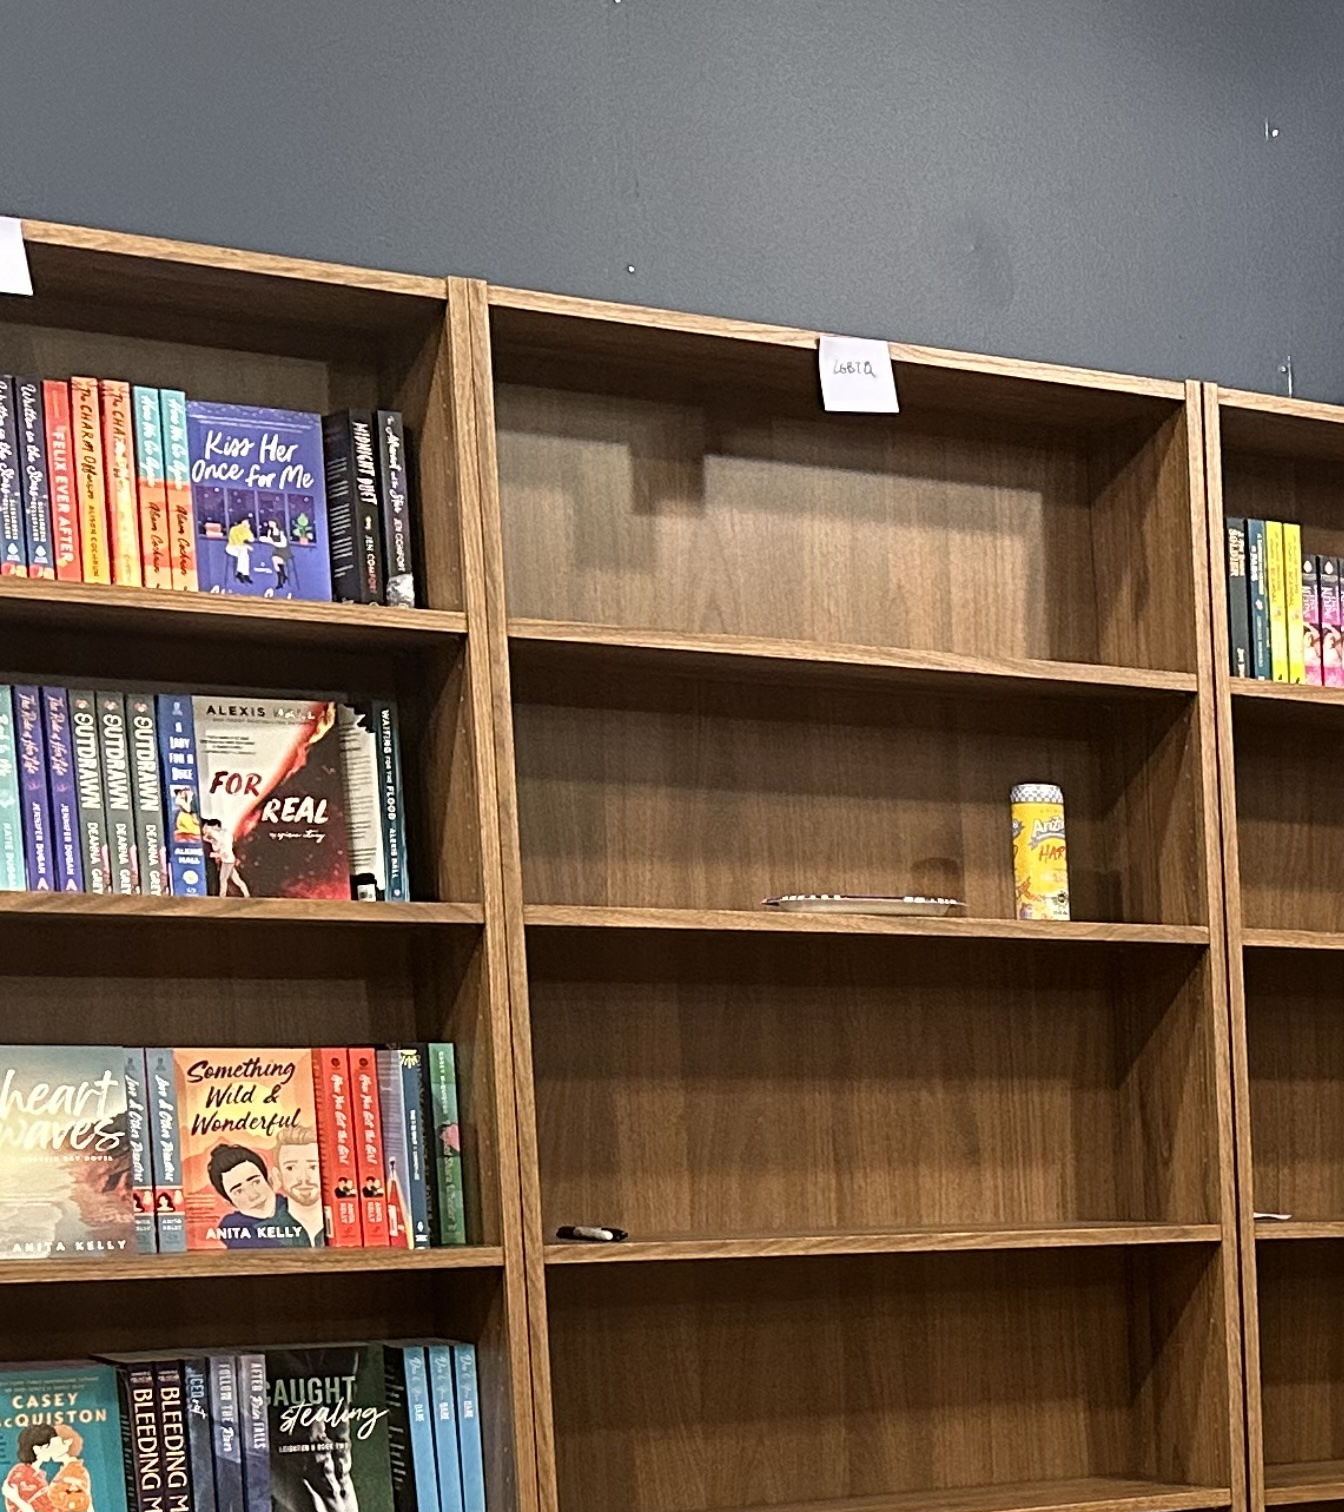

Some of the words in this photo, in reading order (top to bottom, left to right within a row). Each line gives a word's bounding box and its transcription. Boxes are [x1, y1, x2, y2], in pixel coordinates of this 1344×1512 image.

[81, 403, 93, 451] CHARM
[52, 432, 66, 471] FELIX
[205, 430, 256, 459] Kiss
[260, 434, 300, 464] Her
[352, 422, 375, 476] MIDNIGHT
[55, 474, 70, 507] EVER
[191, 460, 244, 483] Once
[246, 465, 278, 487] for
[282, 467, 314, 489] Me
[357, 477, 377, 505] DUET
[58, 517, 73, 562] AFTER
[206, 705, 267, 718] ALEXIS
[381, 709, 392, 754] WAITING
[74, 713, 100, 809] OUTDRAWN
[104, 714, 129, 810] OUTDRAWN
[134, 716, 159, 812] OUTDRAWN
[209, 769, 262, 797] FOR
[261, 796, 329, 825] REAL
[386, 786, 397, 821] FLOOD
[146, 825, 158, 866] DEANNA
[186, 1057, 296, 1085] Something
[0, 1069, 119, 1120] heart
[205, 1084, 255, 1110] Wild
[191, 1107, 301, 1137] Wonderful
[76, 1239, 127, 1250] KELLY
[206, 1226, 251, 1241] ANITA
[256, 1225, 303, 1239] KELLY
[12, 1392, 79, 1409] CASEY
[0, 1409, 107, 1428] cQUISTON
[279, 1397, 390, 1440] stealing
[133, 1389, 161, 1491] BLEEDING
[160, 1387, 188, 1488] BLEEDING
